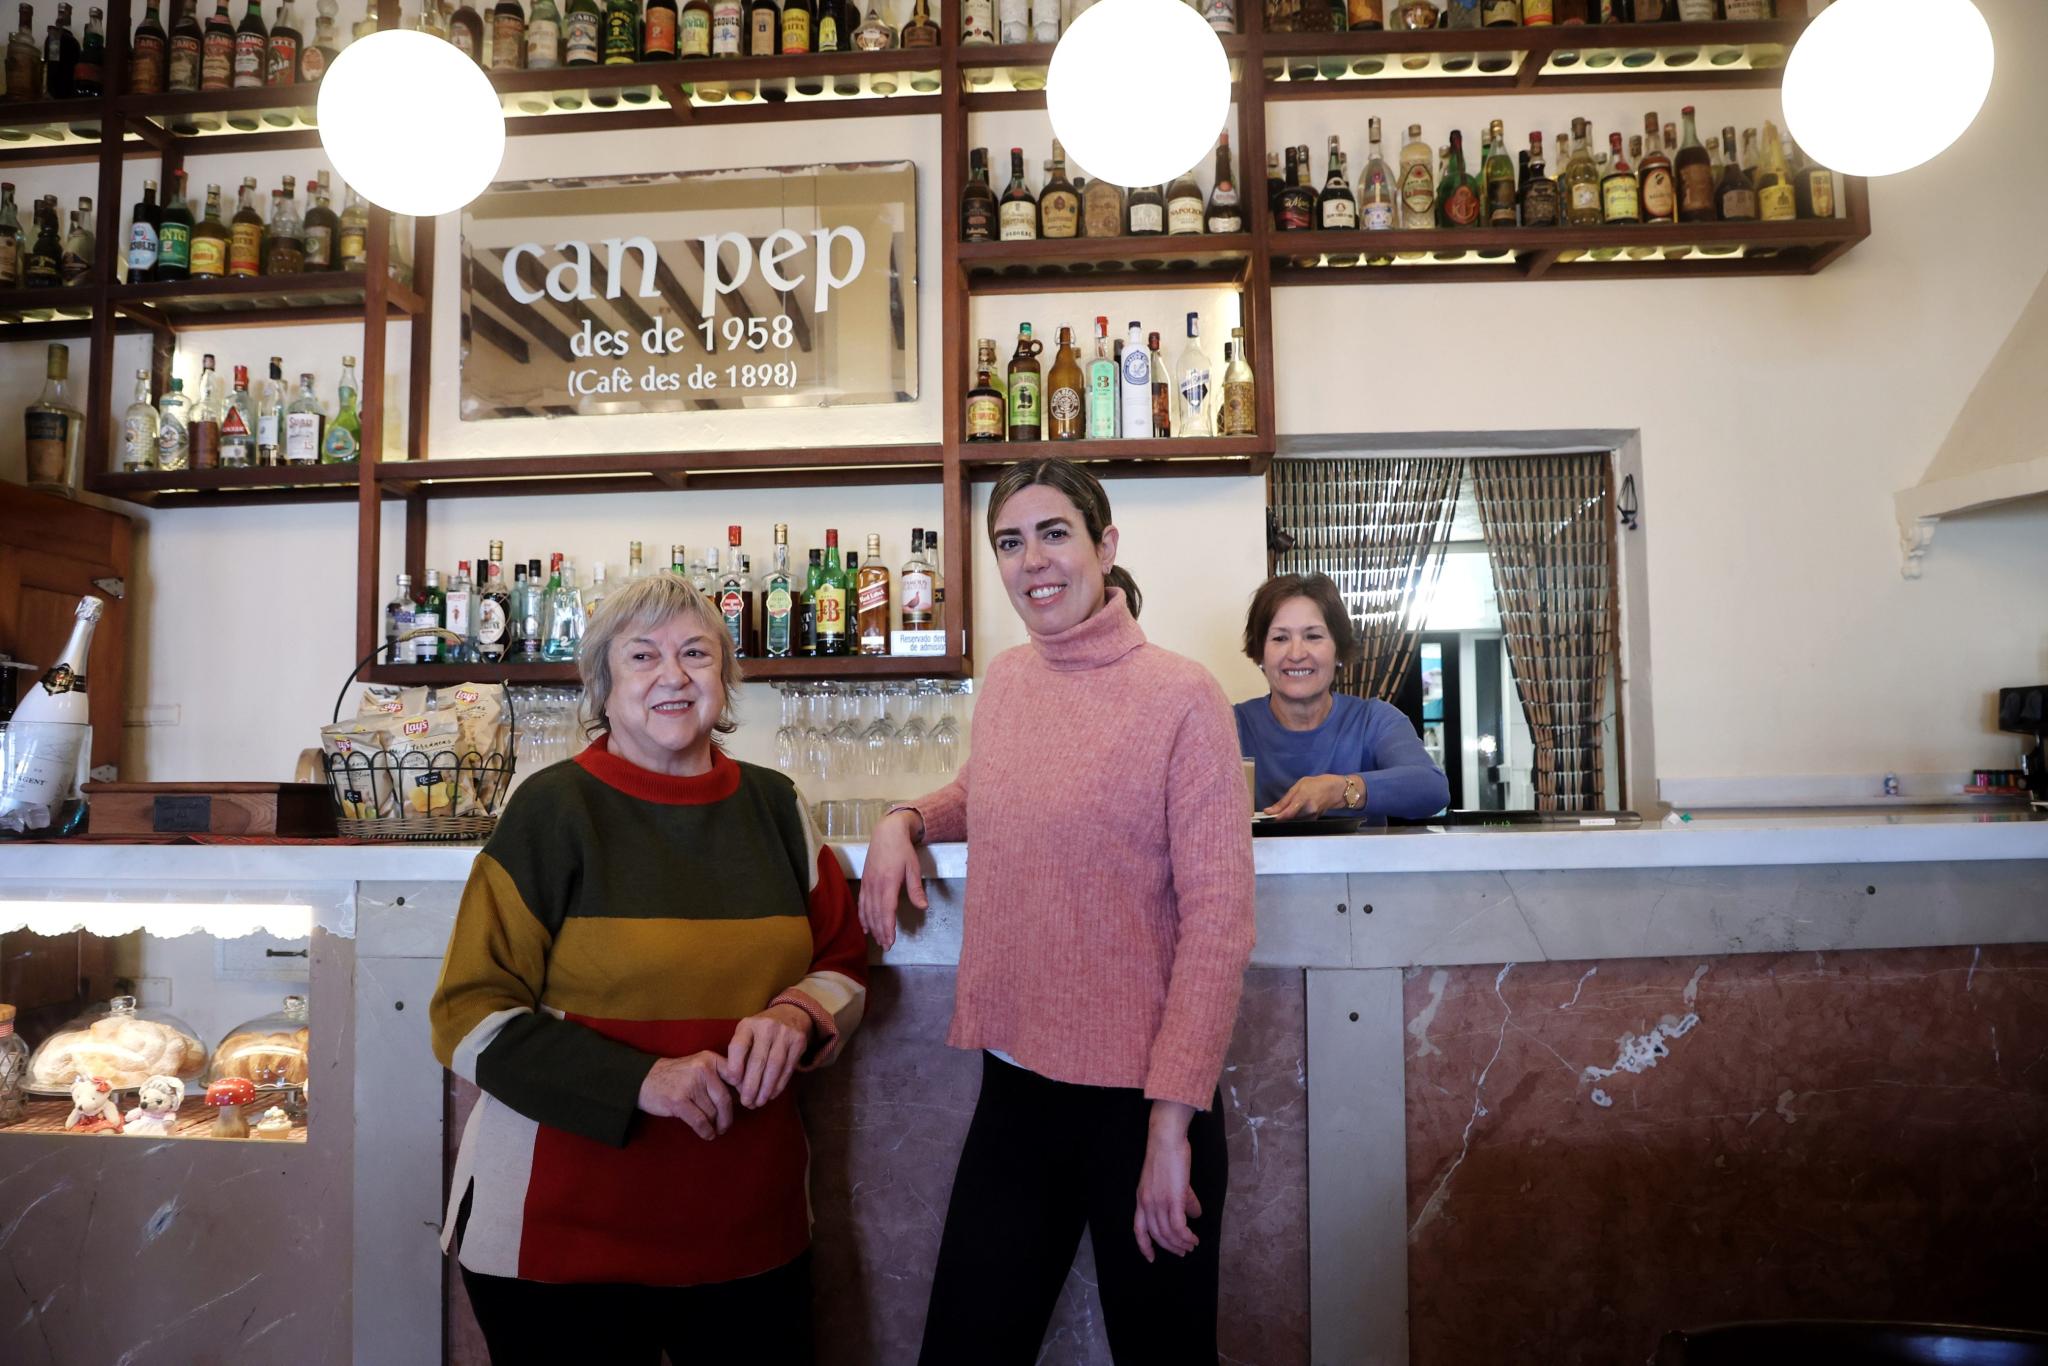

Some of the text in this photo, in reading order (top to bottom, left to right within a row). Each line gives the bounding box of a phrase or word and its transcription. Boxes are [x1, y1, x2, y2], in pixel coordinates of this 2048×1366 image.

[502, 225, 866, 318] can pep
[570, 314, 794, 357] des de 1958
[567, 360, 798, 398] (Cafè des de 1898)
[404, 719, 429, 736] Lay's
